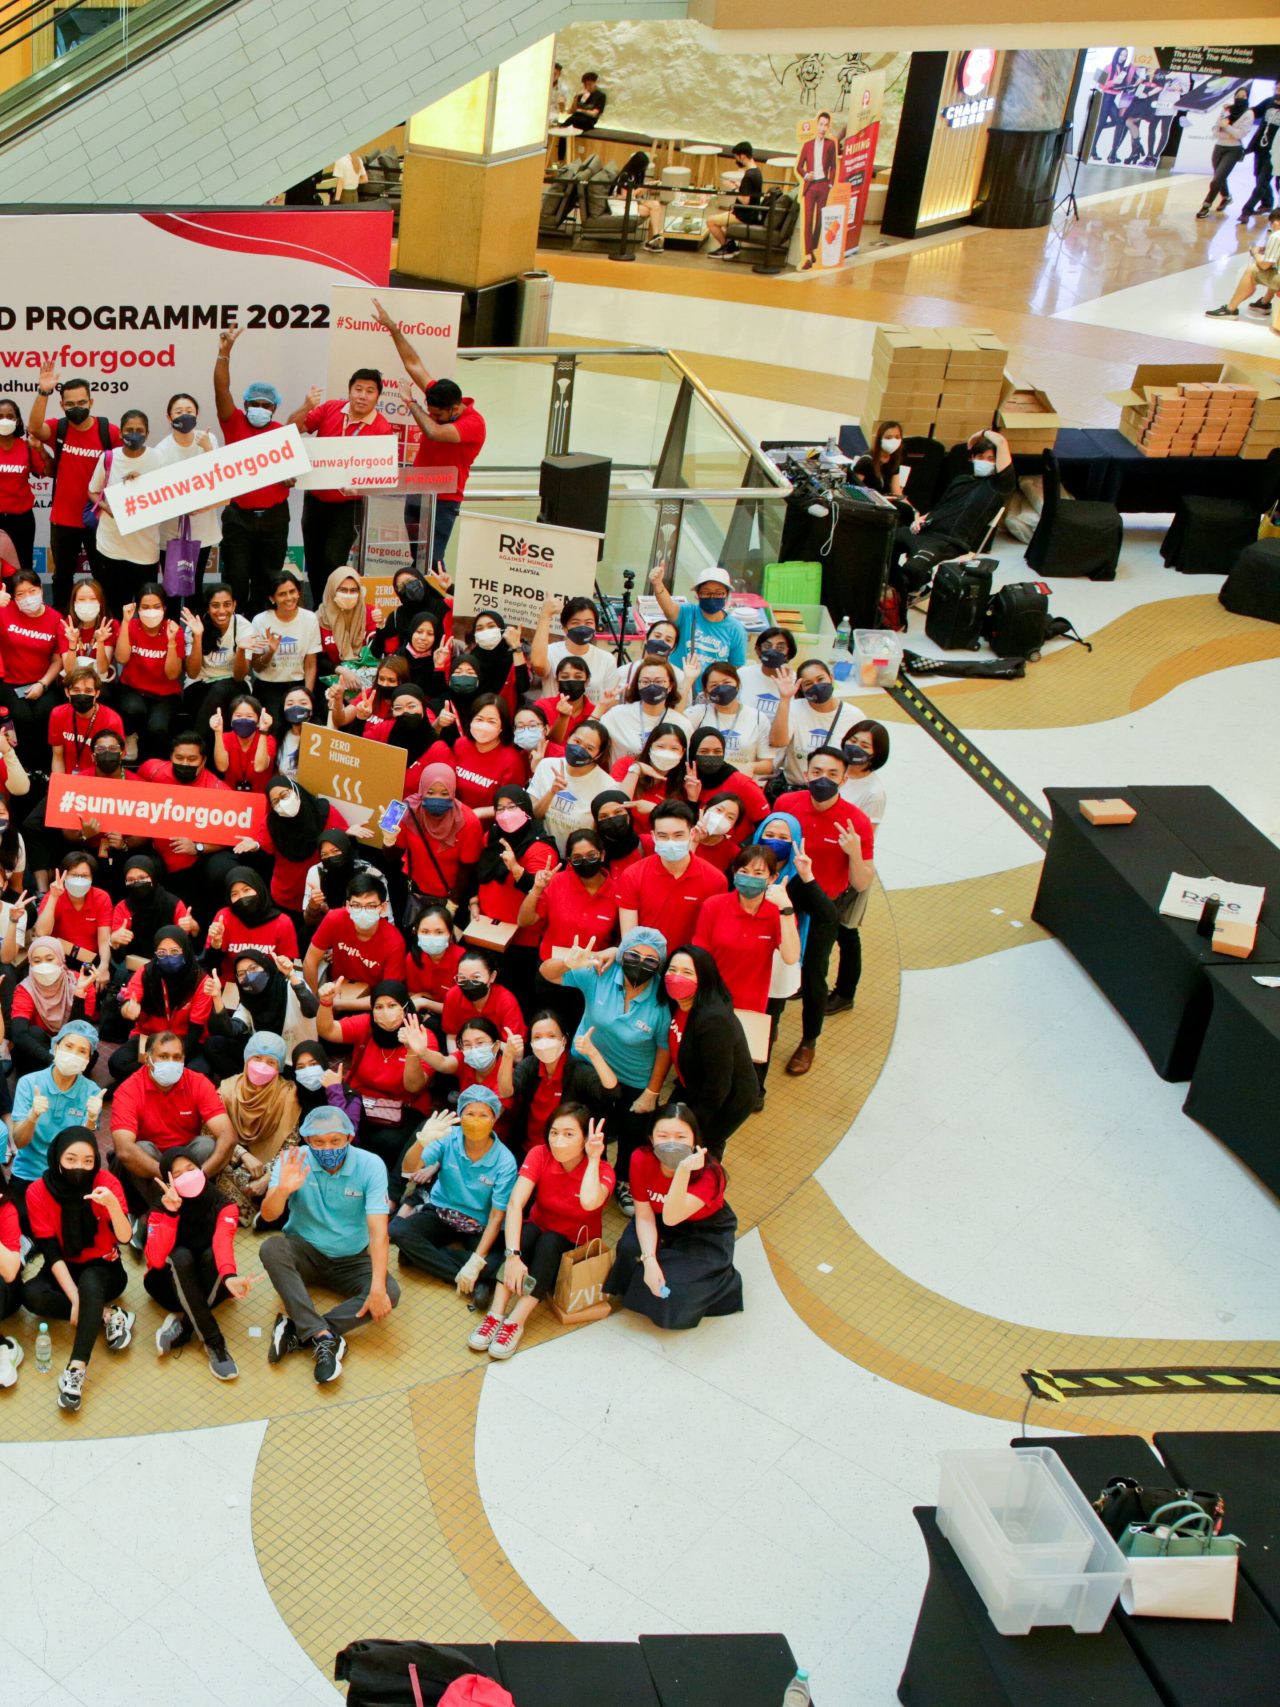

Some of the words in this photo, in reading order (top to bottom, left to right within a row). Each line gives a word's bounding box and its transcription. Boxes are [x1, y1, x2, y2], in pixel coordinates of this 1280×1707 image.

[26, 305, 239, 330] PROGRAMME
[246, 304, 330, 329] 2022
[62, 443, 103, 458] SUNWAY
[310, 456, 394, 470] unwayforgood
[125, 440, 295, 516] #sunwayforgood
[351, 476, 400, 486] SUNWAY
[499, 555, 525, 563] AGAINST
[527, 559, 553, 568] HUNGER
[509, 567, 540, 576] MALAYSIA
[375, 585, 393, 595] ZERO
[470, 578, 498, 593] THE
[375, 597, 402, 607] HUNGE
[473, 593, 498, 608] 795
[504, 599, 527, 609] People
[503, 607, 528, 616] enough
[530, 610, 541, 618] foo
[508, 614, 532, 624] healthy
[7, 624, 56, 642] SUNWAY
[310, 733, 322, 757] 2
[330, 738, 351, 752] ZERO
[329, 750, 360, 768] HUNGER
[59, 791, 252, 828] #sunwayforgood
